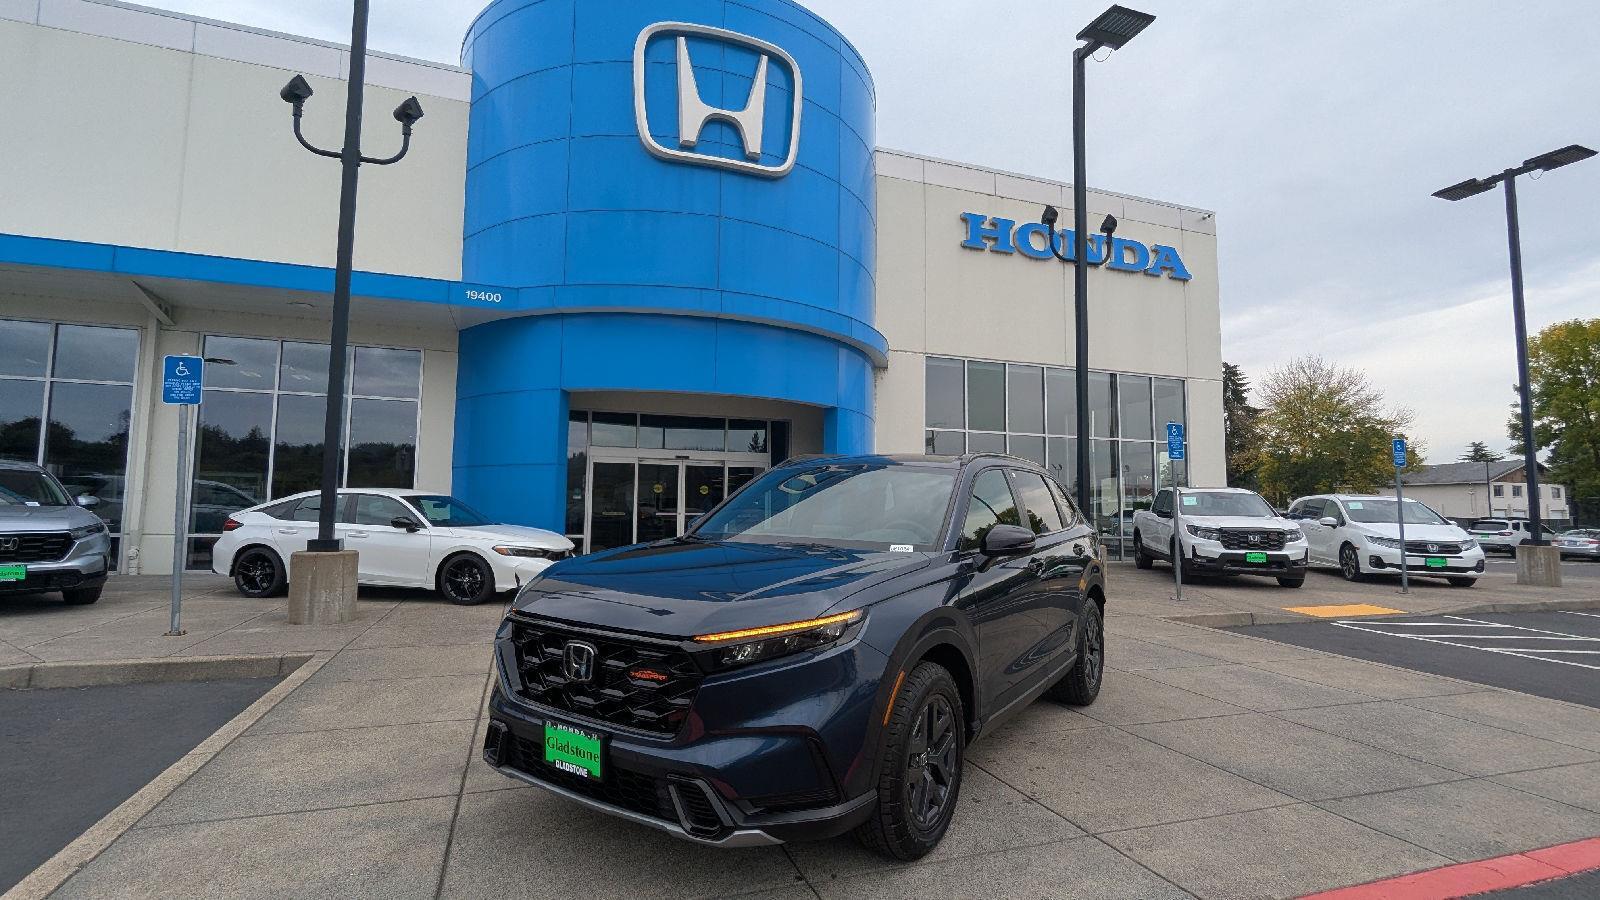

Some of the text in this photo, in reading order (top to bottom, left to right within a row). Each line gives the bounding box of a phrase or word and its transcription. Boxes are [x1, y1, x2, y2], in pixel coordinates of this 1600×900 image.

[960, 212, 1192, 281] HONDA
[465, 290, 502, 303] 19400
[546, 736, 600, 763] Gladstone
[555, 759, 588, 778] GLADSTONE
